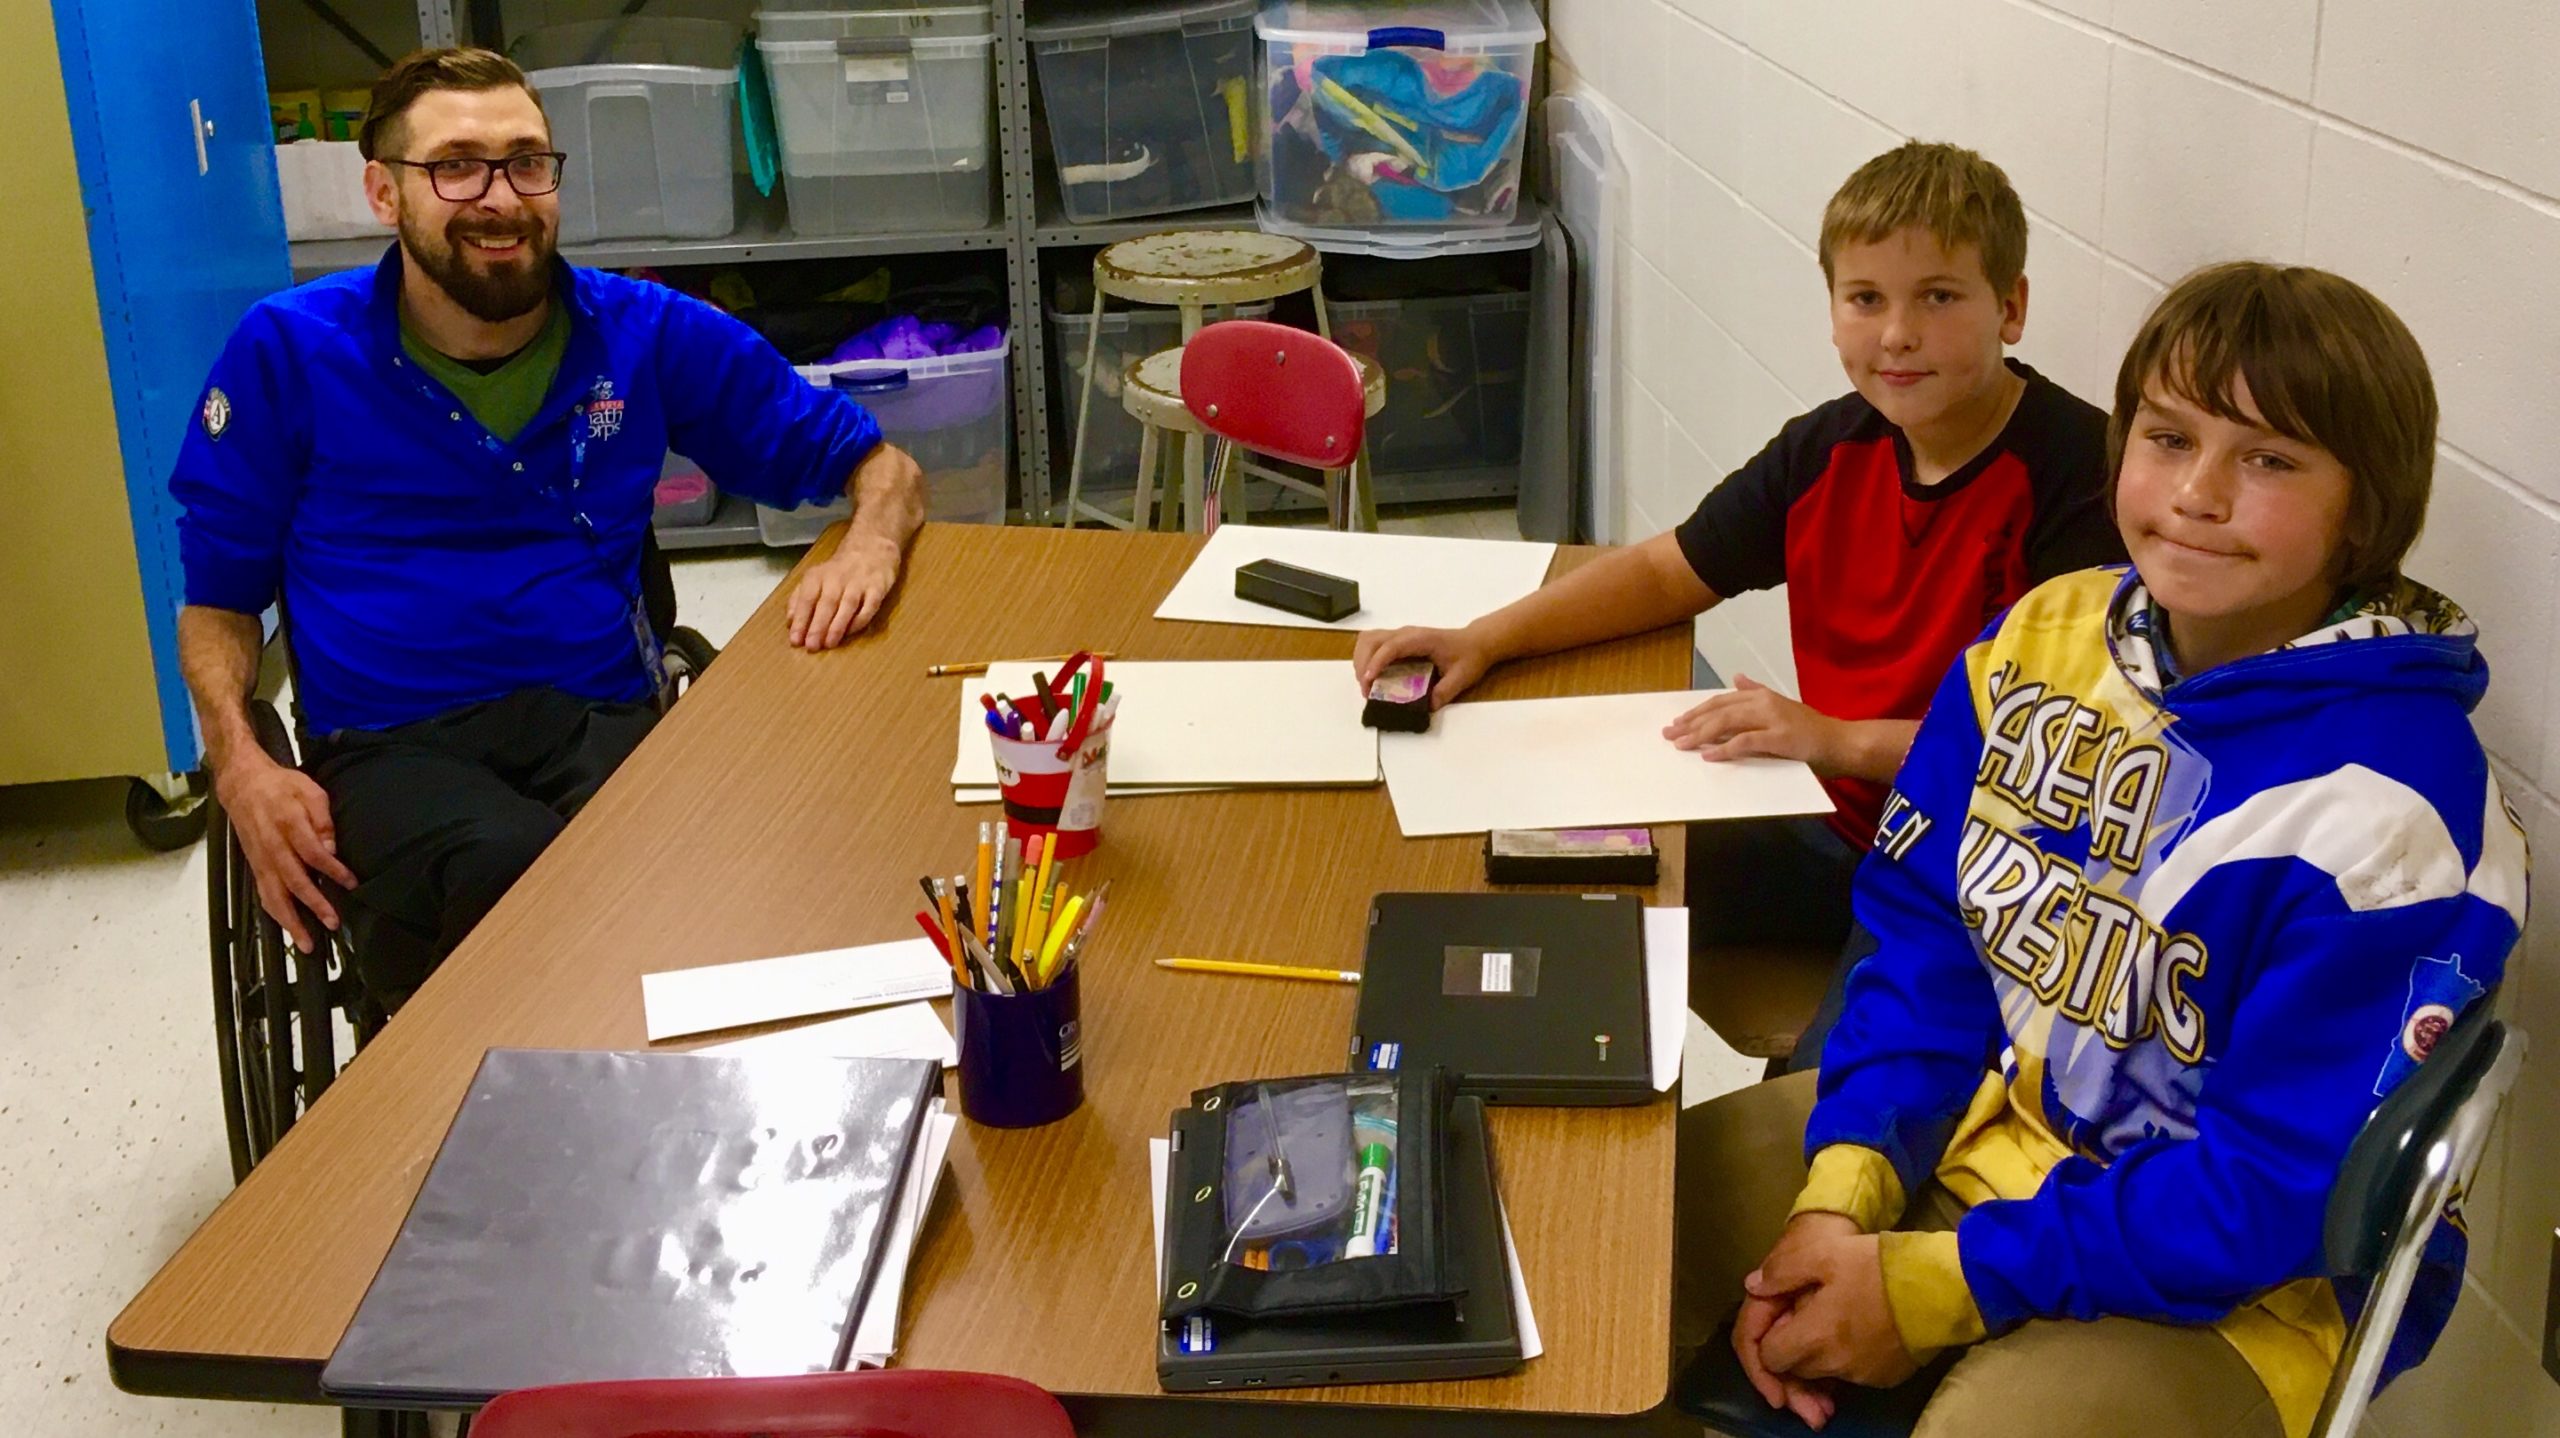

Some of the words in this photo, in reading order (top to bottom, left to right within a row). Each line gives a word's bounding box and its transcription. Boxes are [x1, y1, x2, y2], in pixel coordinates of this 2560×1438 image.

[588, 408, 623, 425] ath
[588, 423, 622, 441] orps
[1977, 661, 2170, 873] ASEA
